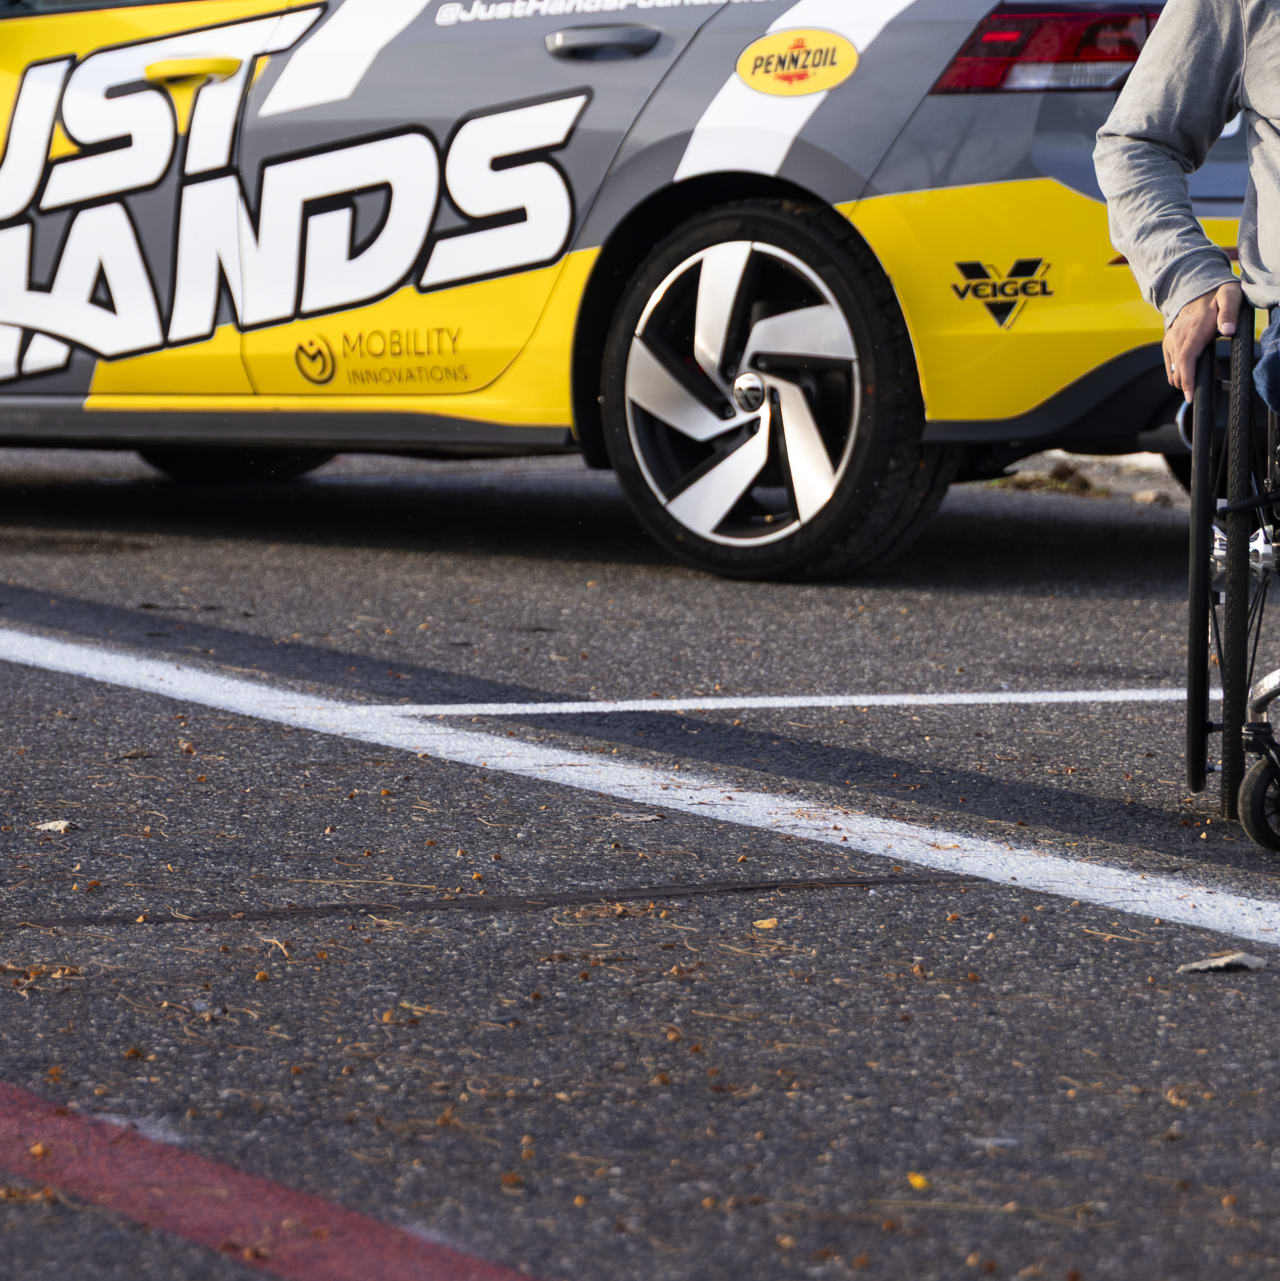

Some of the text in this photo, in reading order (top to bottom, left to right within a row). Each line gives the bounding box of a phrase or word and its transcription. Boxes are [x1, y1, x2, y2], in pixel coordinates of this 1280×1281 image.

[751, 47, 837, 75] PENNZOIL
[951, 279, 1055, 301] VEIGEL
[342, 326, 462, 359] MOBILITY
[347, 364, 469, 386] INNOVATIONS
